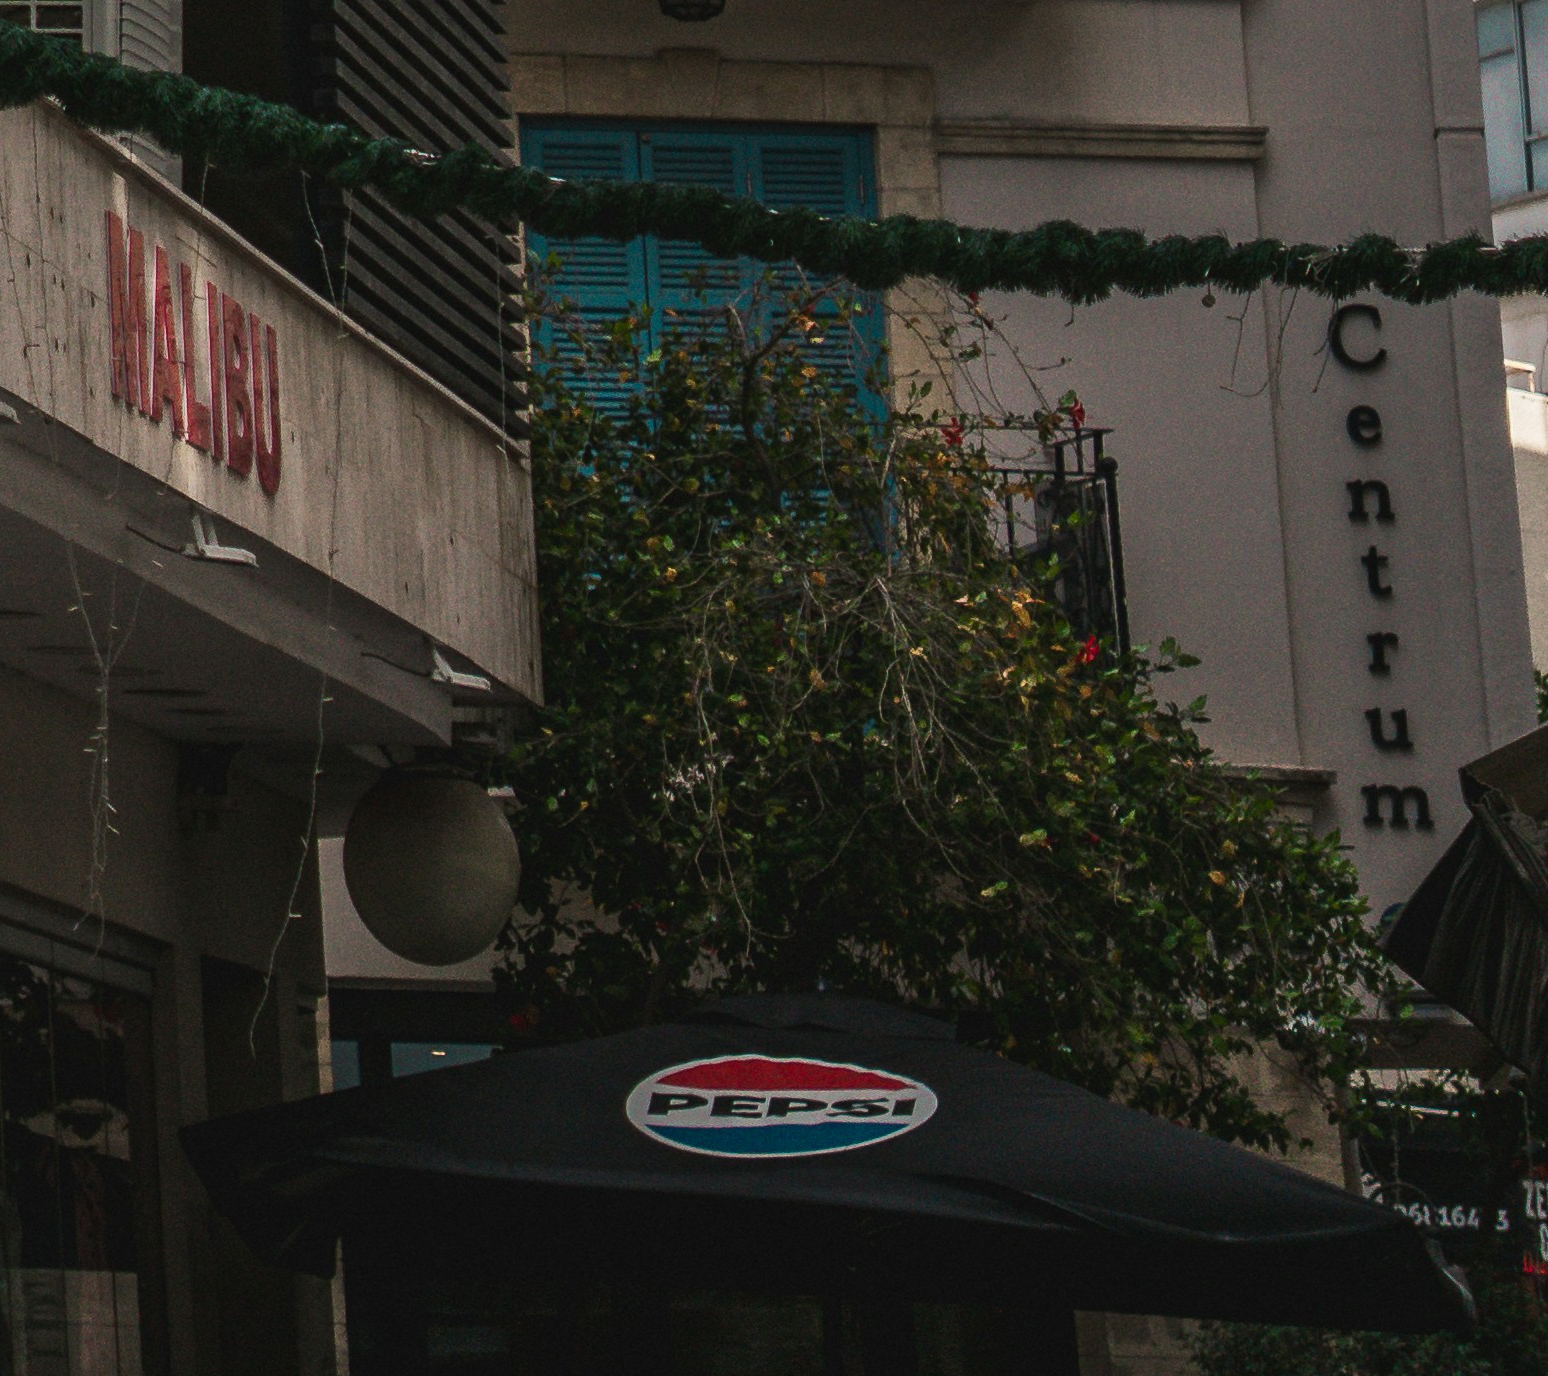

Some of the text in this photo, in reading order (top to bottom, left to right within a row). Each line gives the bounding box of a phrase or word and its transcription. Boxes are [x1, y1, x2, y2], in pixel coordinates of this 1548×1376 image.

[106, 210, 283, 496] MALIBU
[1329, 302, 1433, 830] Centrum
[645, 1091, 917, 1121] PEPSI
